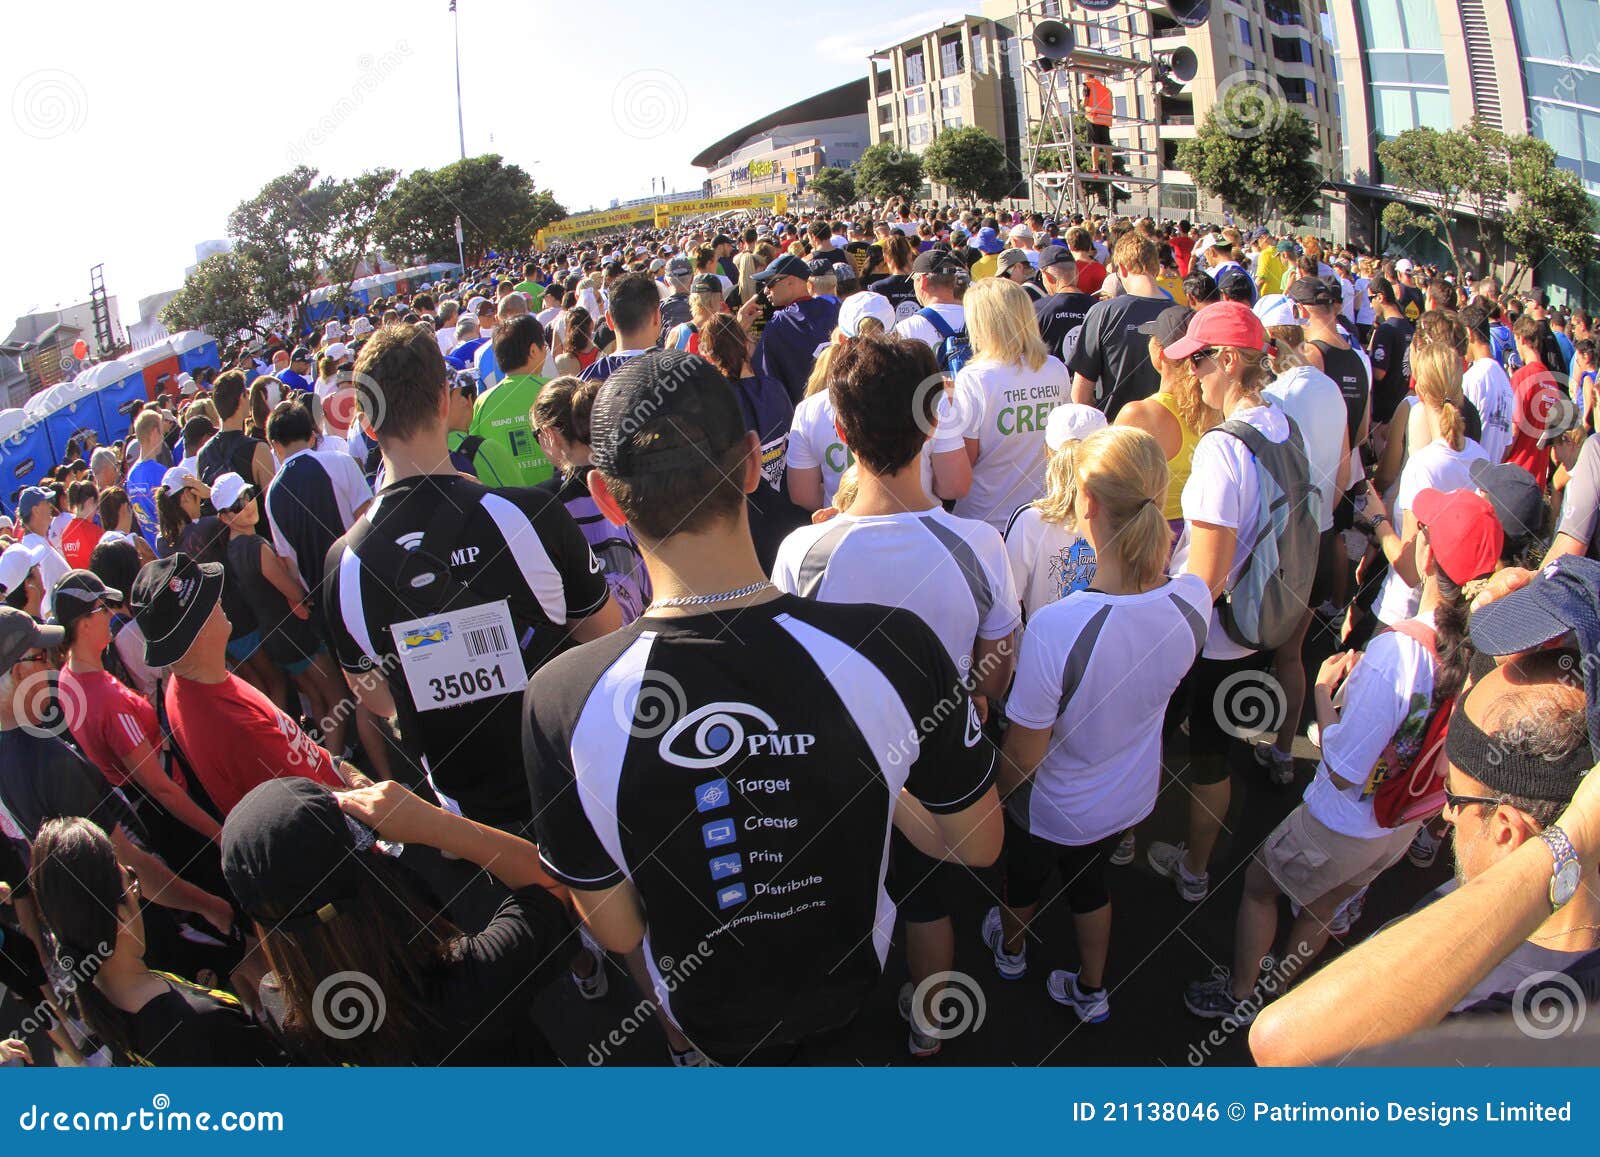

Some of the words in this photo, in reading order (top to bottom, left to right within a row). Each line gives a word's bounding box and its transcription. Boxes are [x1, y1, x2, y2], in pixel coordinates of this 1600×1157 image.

[1003, 388, 1028, 403] THE
[1030, 385, 1060, 399] CHEW
[996, 401, 1061, 436] CRE
[450, 546, 480, 567] MP
[428, 664, 506, 702] 35061
[746, 732, 816, 757] PMP
[737, 777, 791, 796] Target
[744, 815, 799, 831] Create
[749, 849, 784, 865] Print
[754, 873, 823, 897] Distribute
[705, 899, 827, 940] www.pmplimited.co.nz
